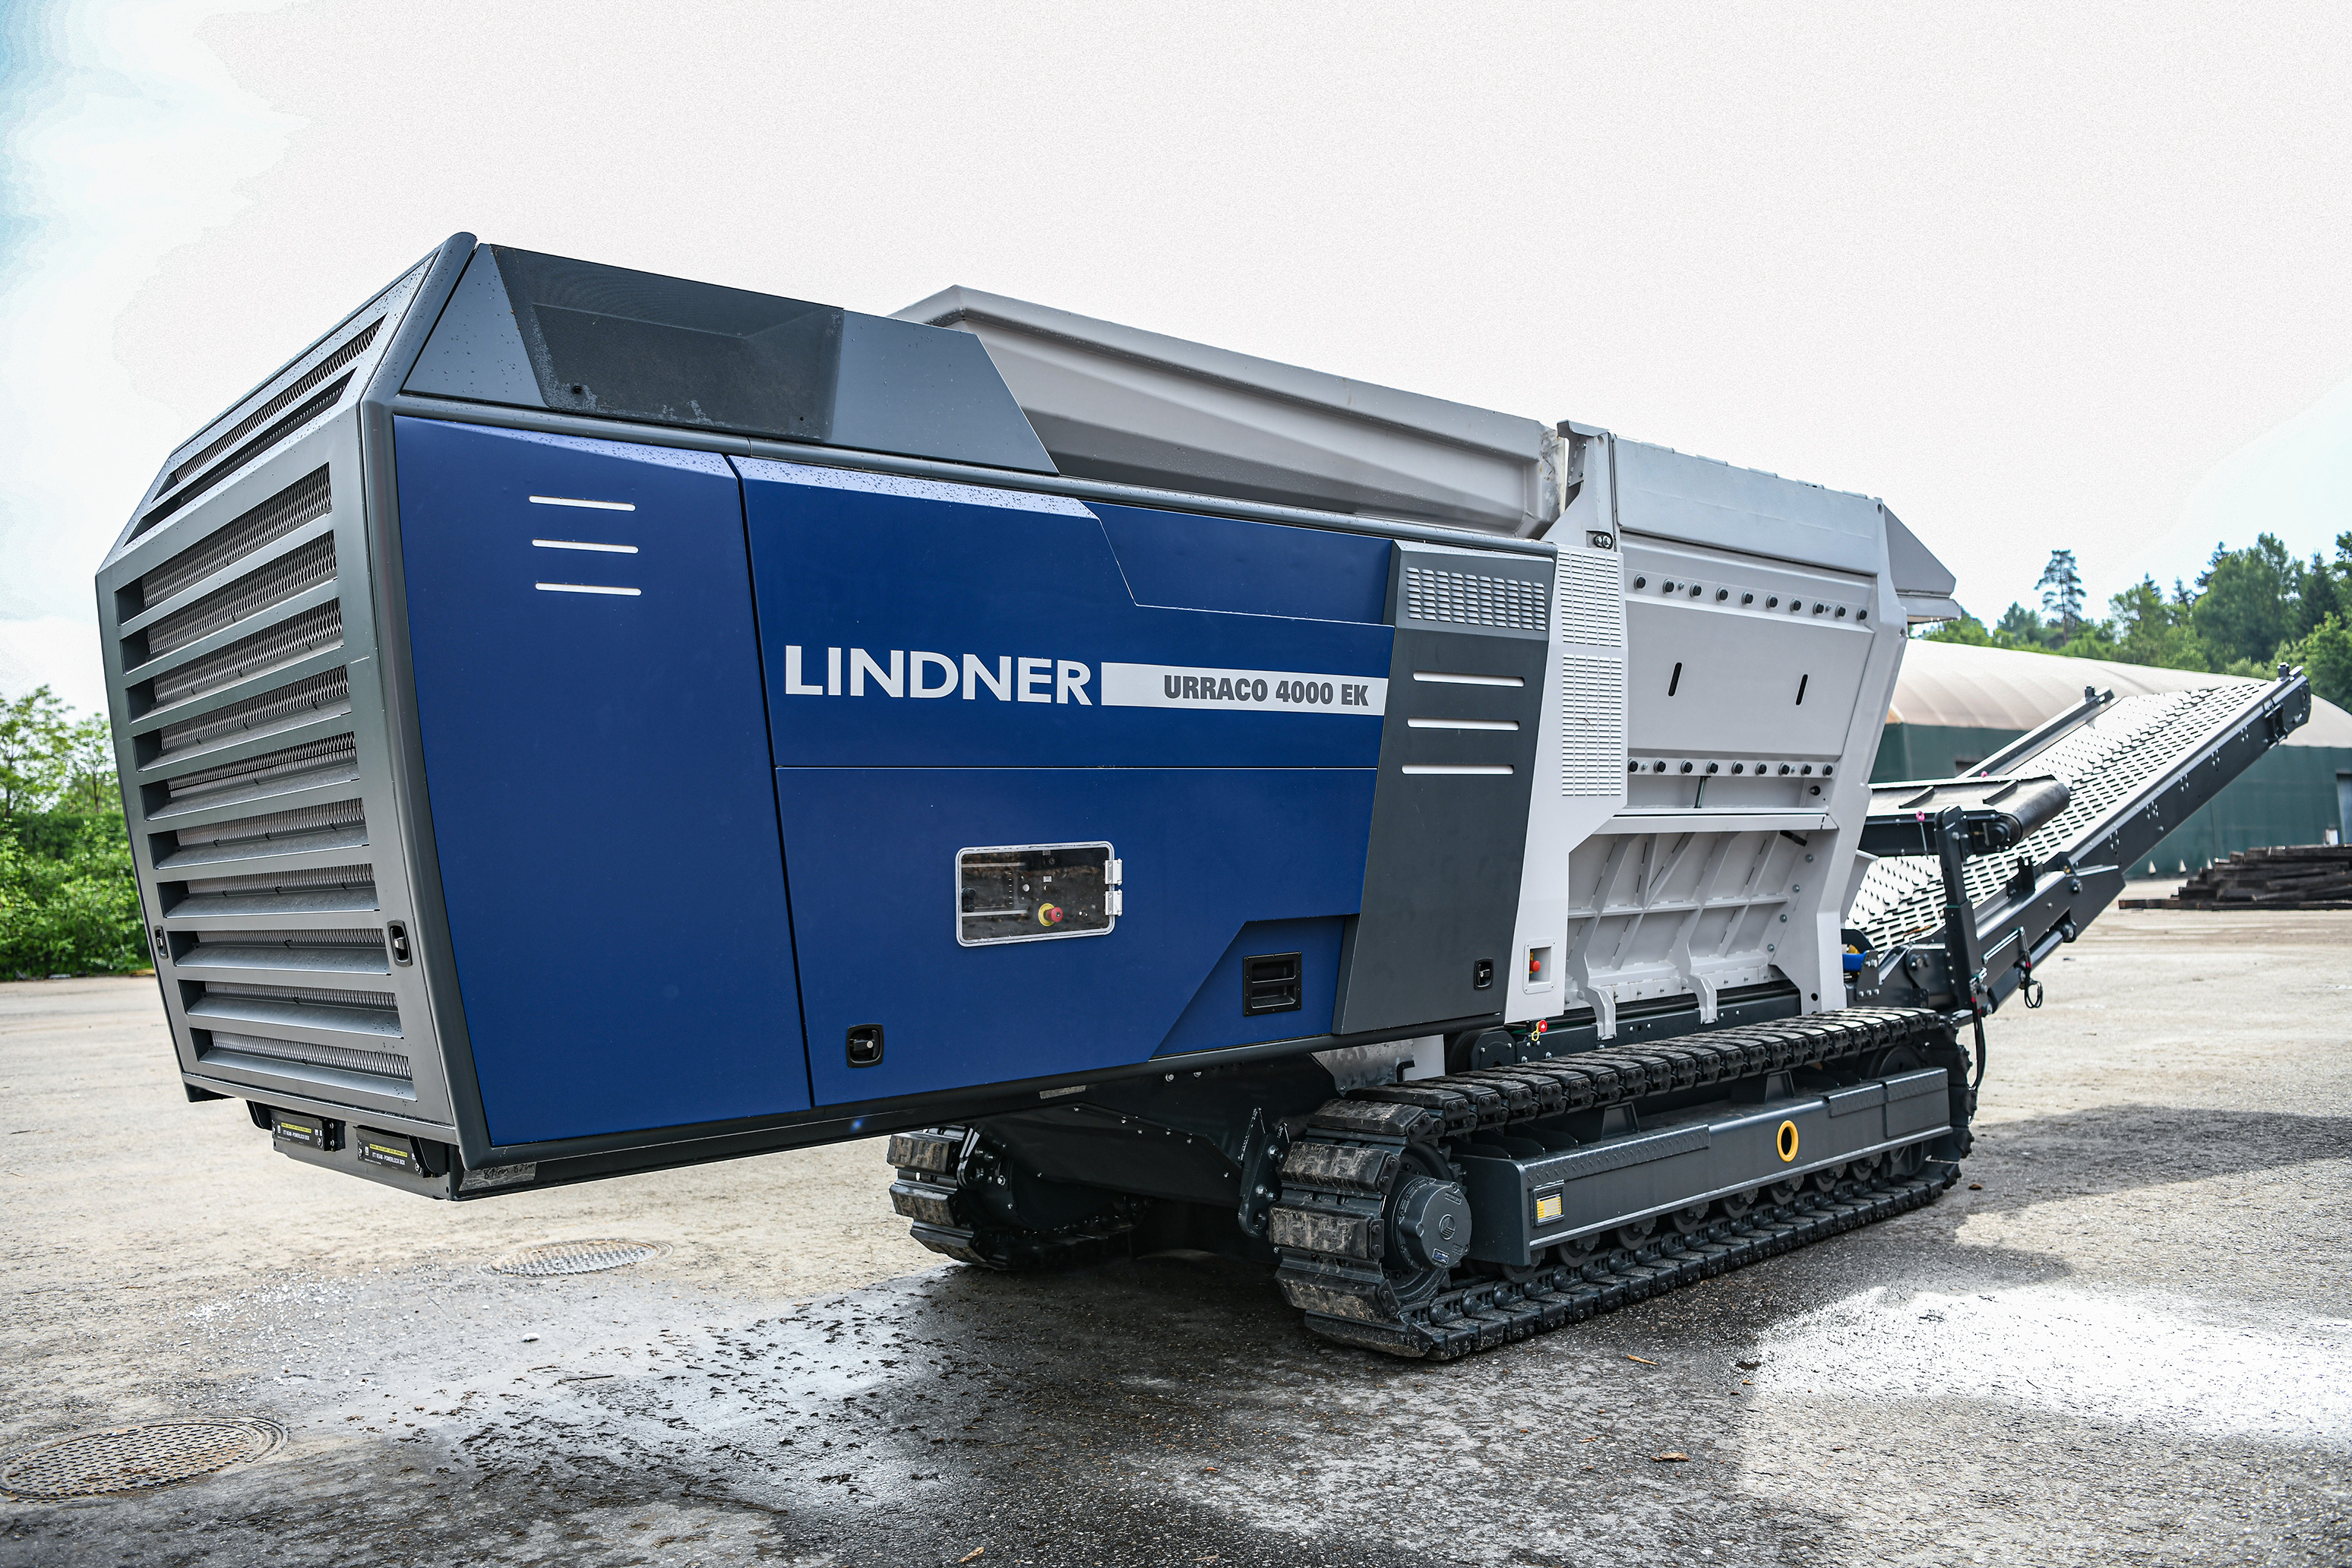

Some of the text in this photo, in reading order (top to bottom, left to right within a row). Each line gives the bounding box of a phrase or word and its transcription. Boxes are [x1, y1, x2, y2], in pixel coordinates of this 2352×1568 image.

[786, 645, 1093, 706] LINDNER
[1164, 675, 1369, 707] URRACO 4000 EK
